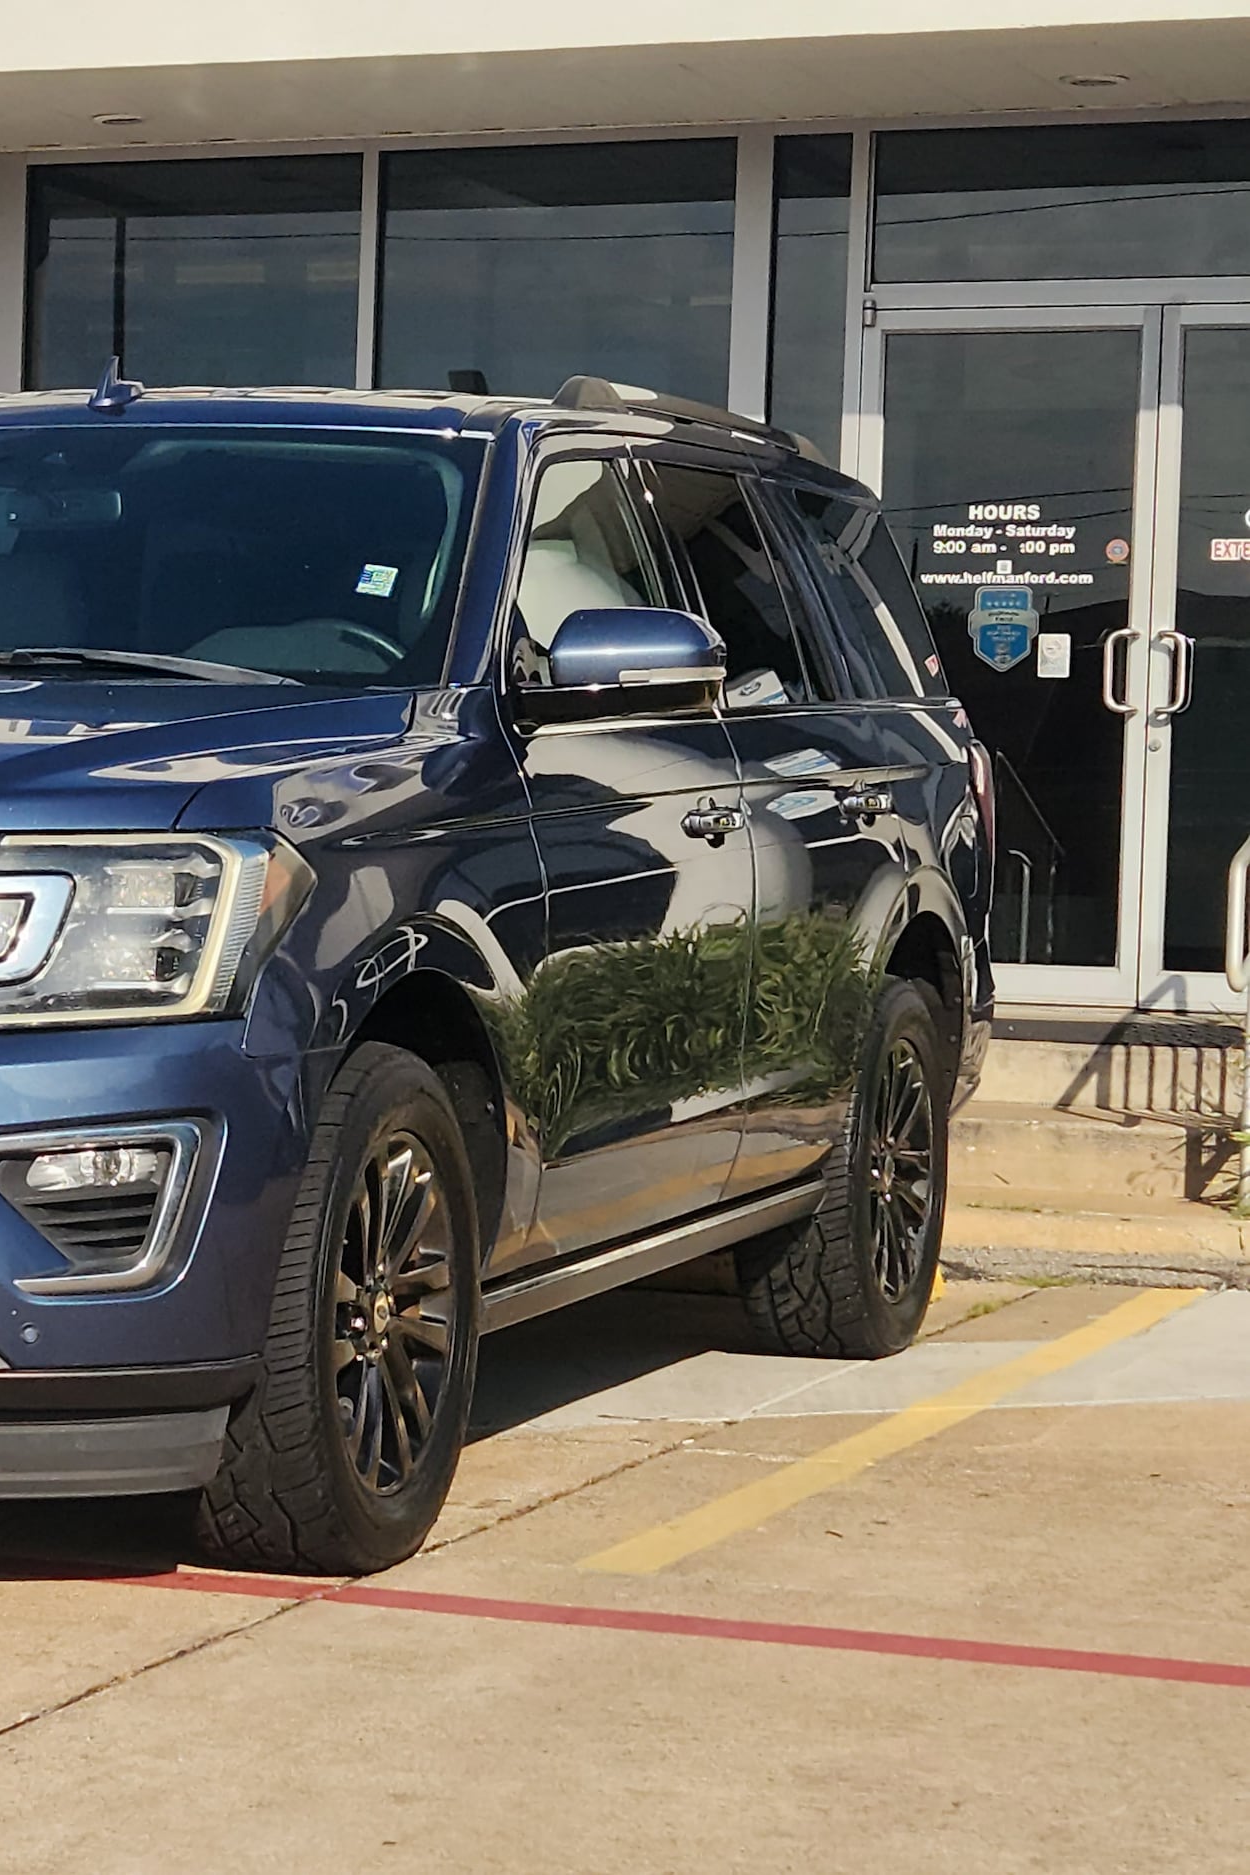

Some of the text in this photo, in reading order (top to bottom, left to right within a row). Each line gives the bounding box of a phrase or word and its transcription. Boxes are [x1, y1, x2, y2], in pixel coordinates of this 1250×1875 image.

[968, 504, 1041, 521] HOURS
[932, 524, 994, 539] Monday
[1005, 524, 1076, 539] Saturday
[932, 540, 967, 554] 9:00
[970, 542, 997, 554] am
[1049, 543, 1076, 556] pm
